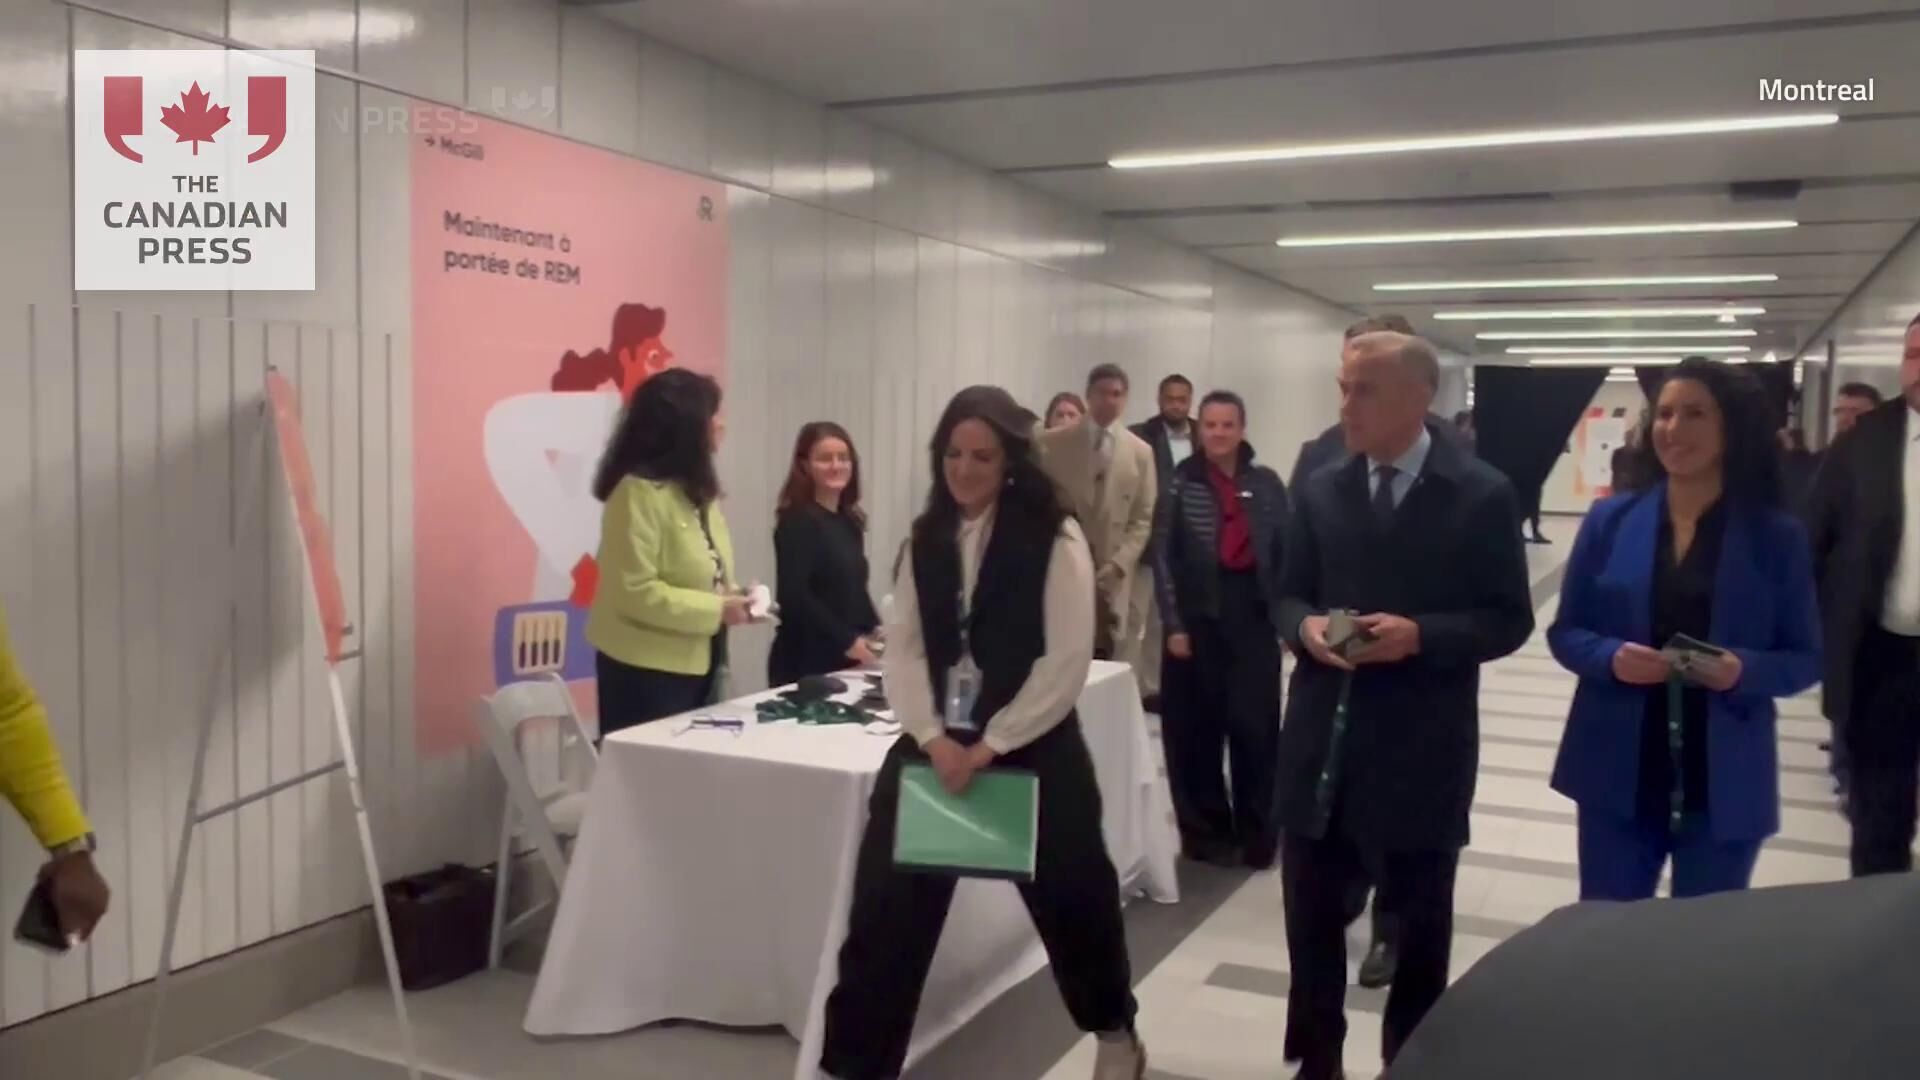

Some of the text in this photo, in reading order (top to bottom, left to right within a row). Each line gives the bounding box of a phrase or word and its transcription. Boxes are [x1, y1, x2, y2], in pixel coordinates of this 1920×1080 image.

[444, 210, 572, 253] Maintenant à
[444, 250, 581, 285] portée de REM
